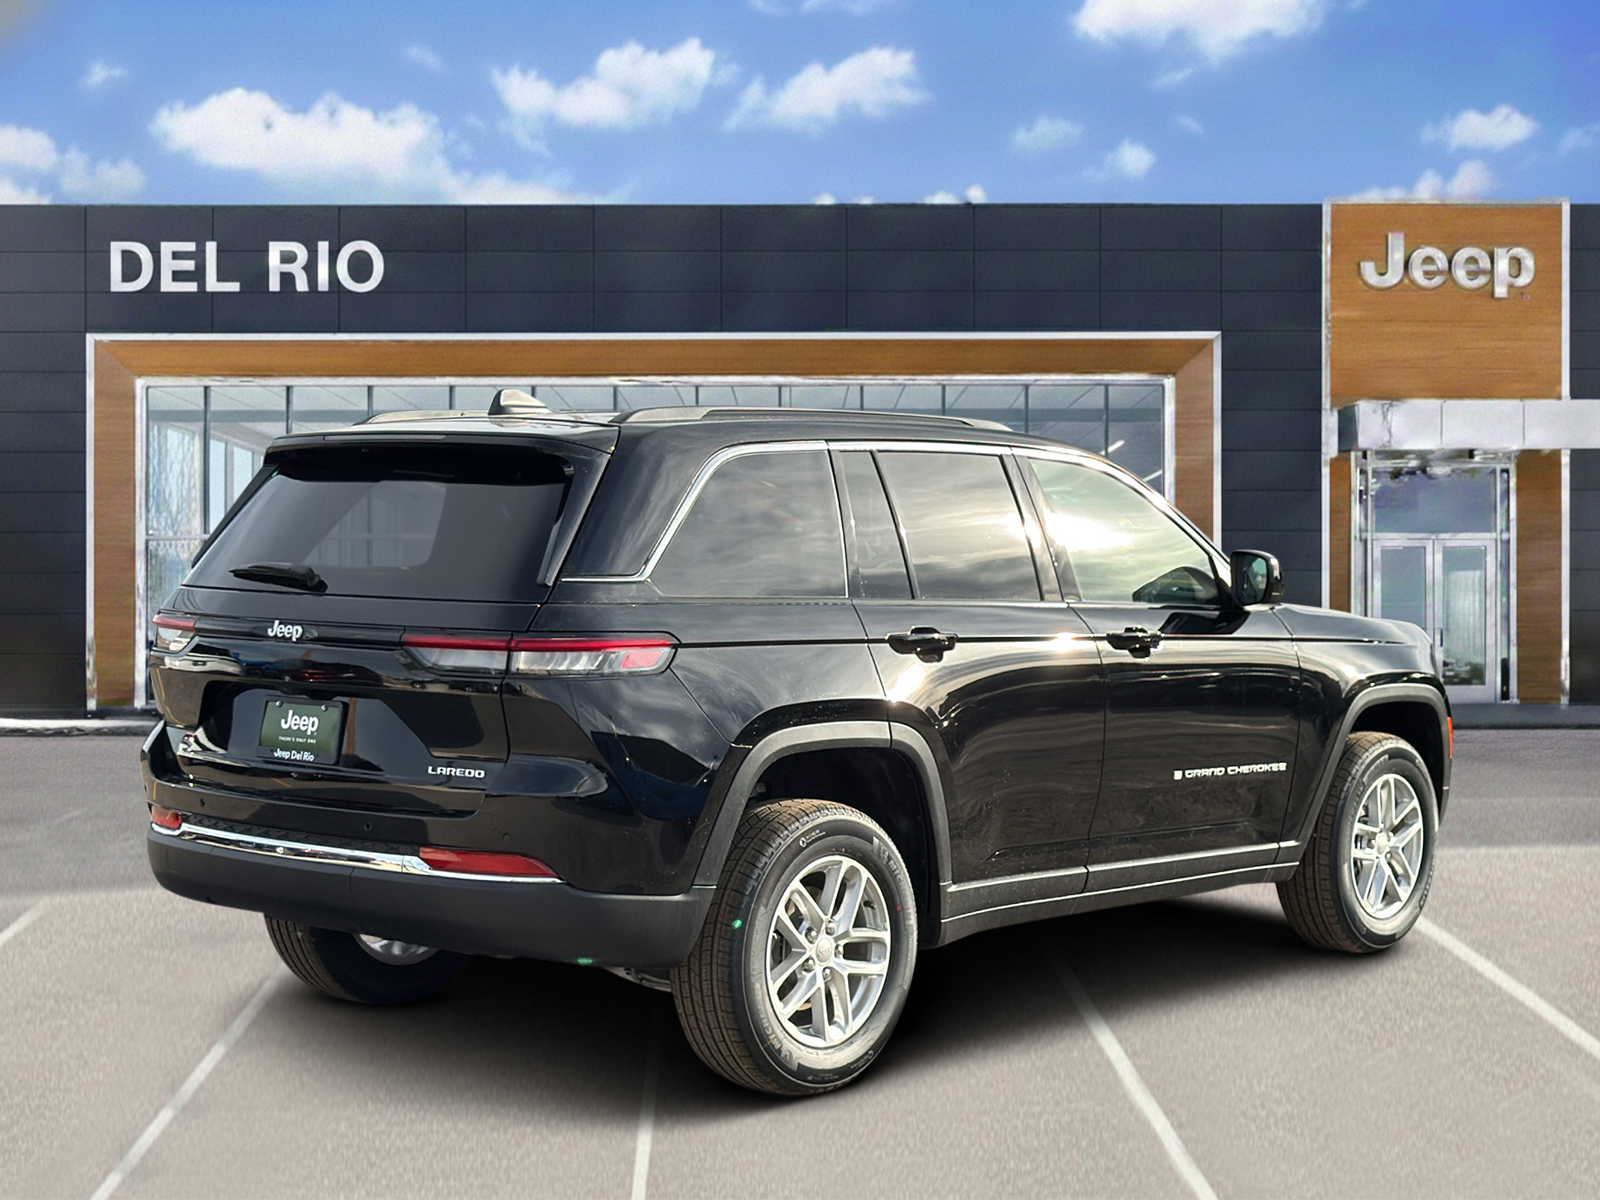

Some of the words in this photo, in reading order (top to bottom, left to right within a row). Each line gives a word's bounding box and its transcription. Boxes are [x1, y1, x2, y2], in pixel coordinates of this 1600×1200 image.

[110, 241, 240, 292] DEL
[268, 240, 384, 293] RIO
[1360, 232, 1535, 298] Jeep
[267, 620, 303, 641] Jeep
[280, 709, 319, 735] Jeep
[273, 747, 291, 760] Jeep
[290, 750, 303, 760] Del
[302, 751, 315, 762] Rio
[427, 765, 485, 779] LAREDO
[1184, 767, 1225, 778] GRAND
[1226, 762, 1287, 775] CHEROKEE
